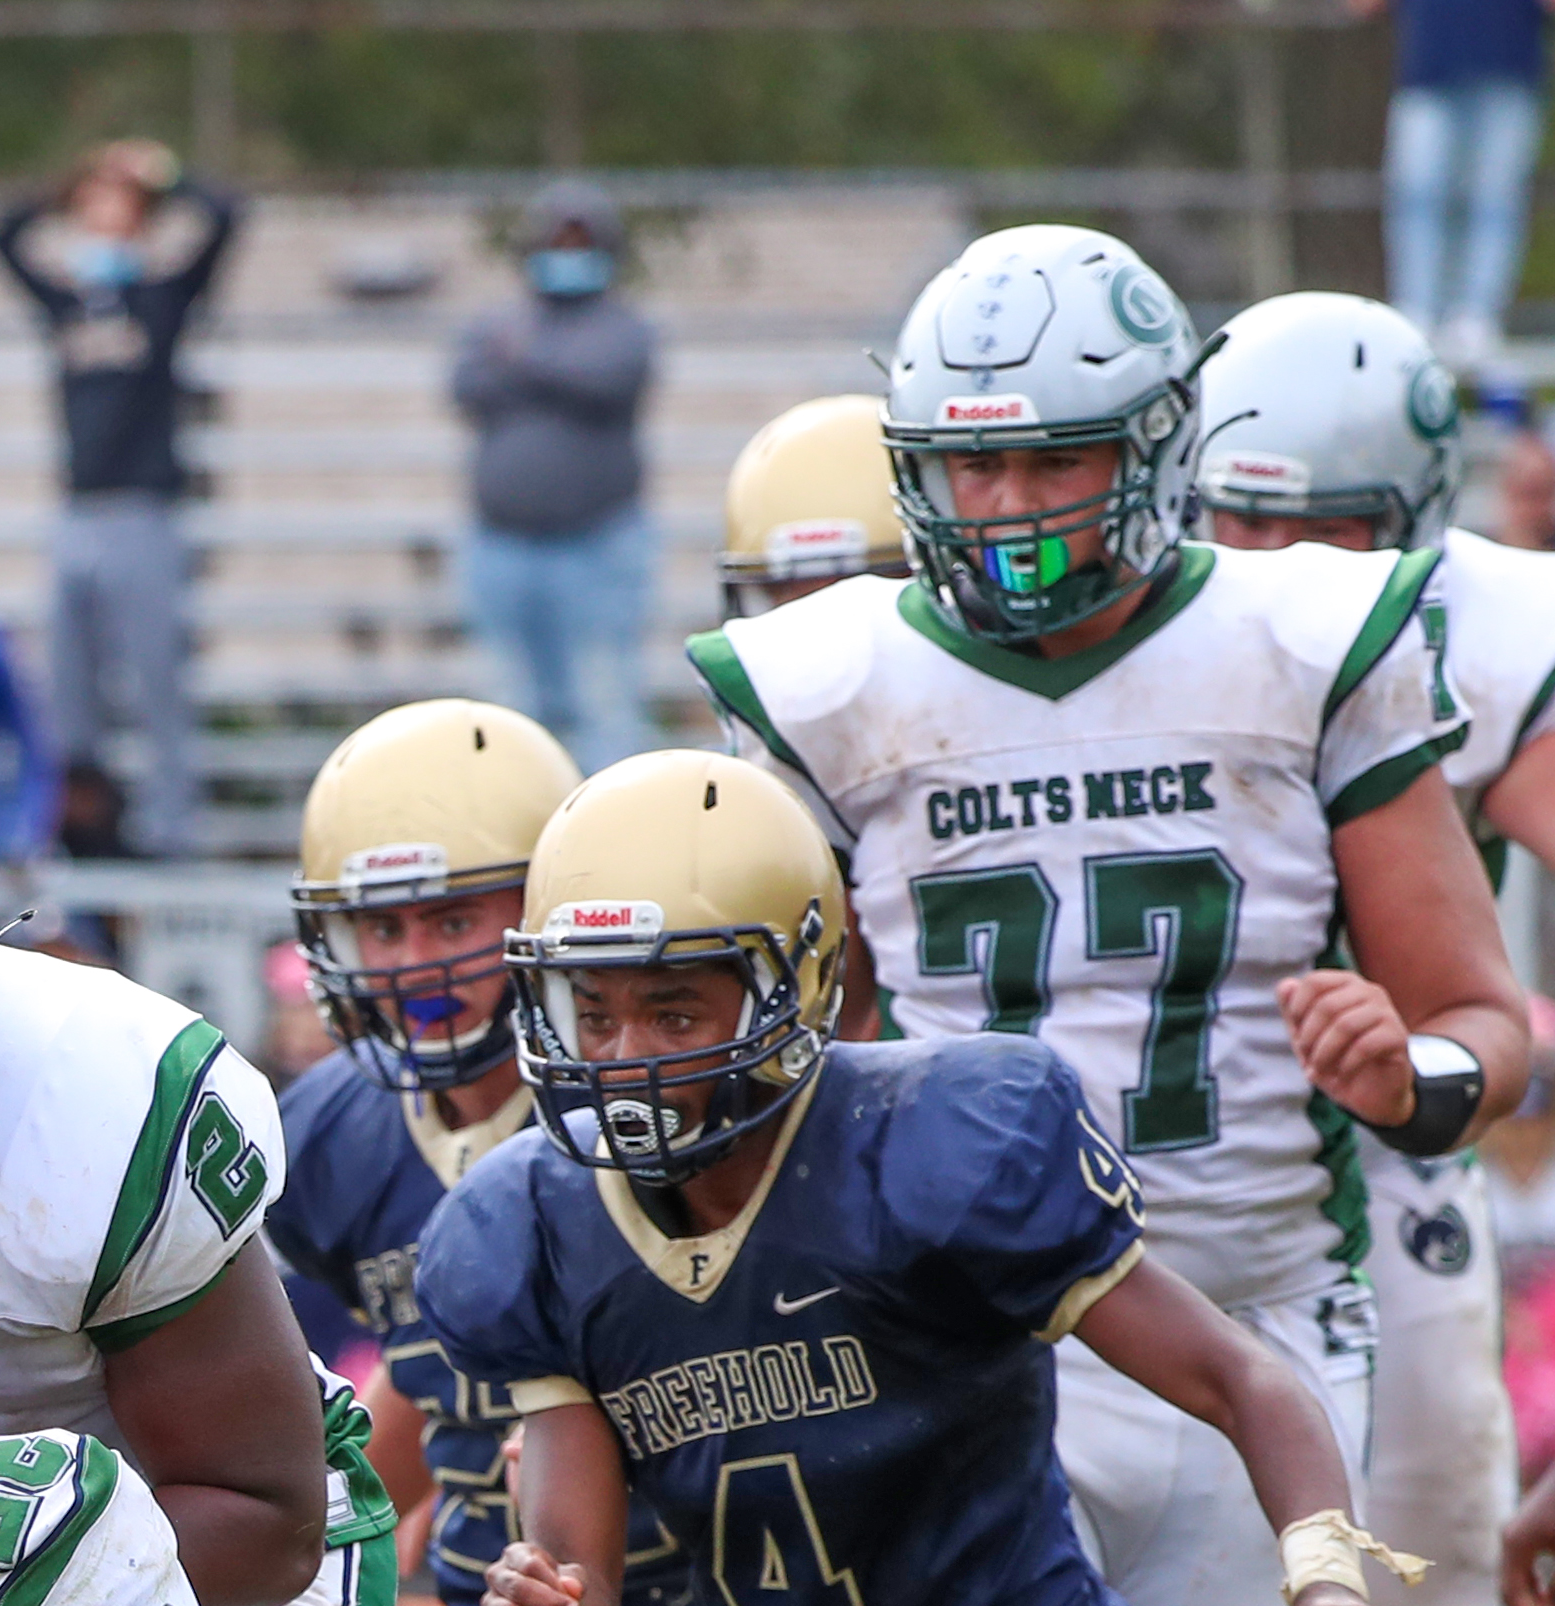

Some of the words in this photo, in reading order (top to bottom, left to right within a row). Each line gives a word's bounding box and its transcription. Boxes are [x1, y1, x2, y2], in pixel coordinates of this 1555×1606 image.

[947, 402, 1023, 421] Riddell
[927, 777, 1071, 841] COLTS
[1084, 760, 1216, 820] NECK
[573, 906, 632, 928] Riddell
[909, 847, 1246, 1155] 77
[185, 1090, 269, 1242] 2
[690, 1253, 710, 1286] F
[599, 1334, 879, 1460] FREEHOLD
